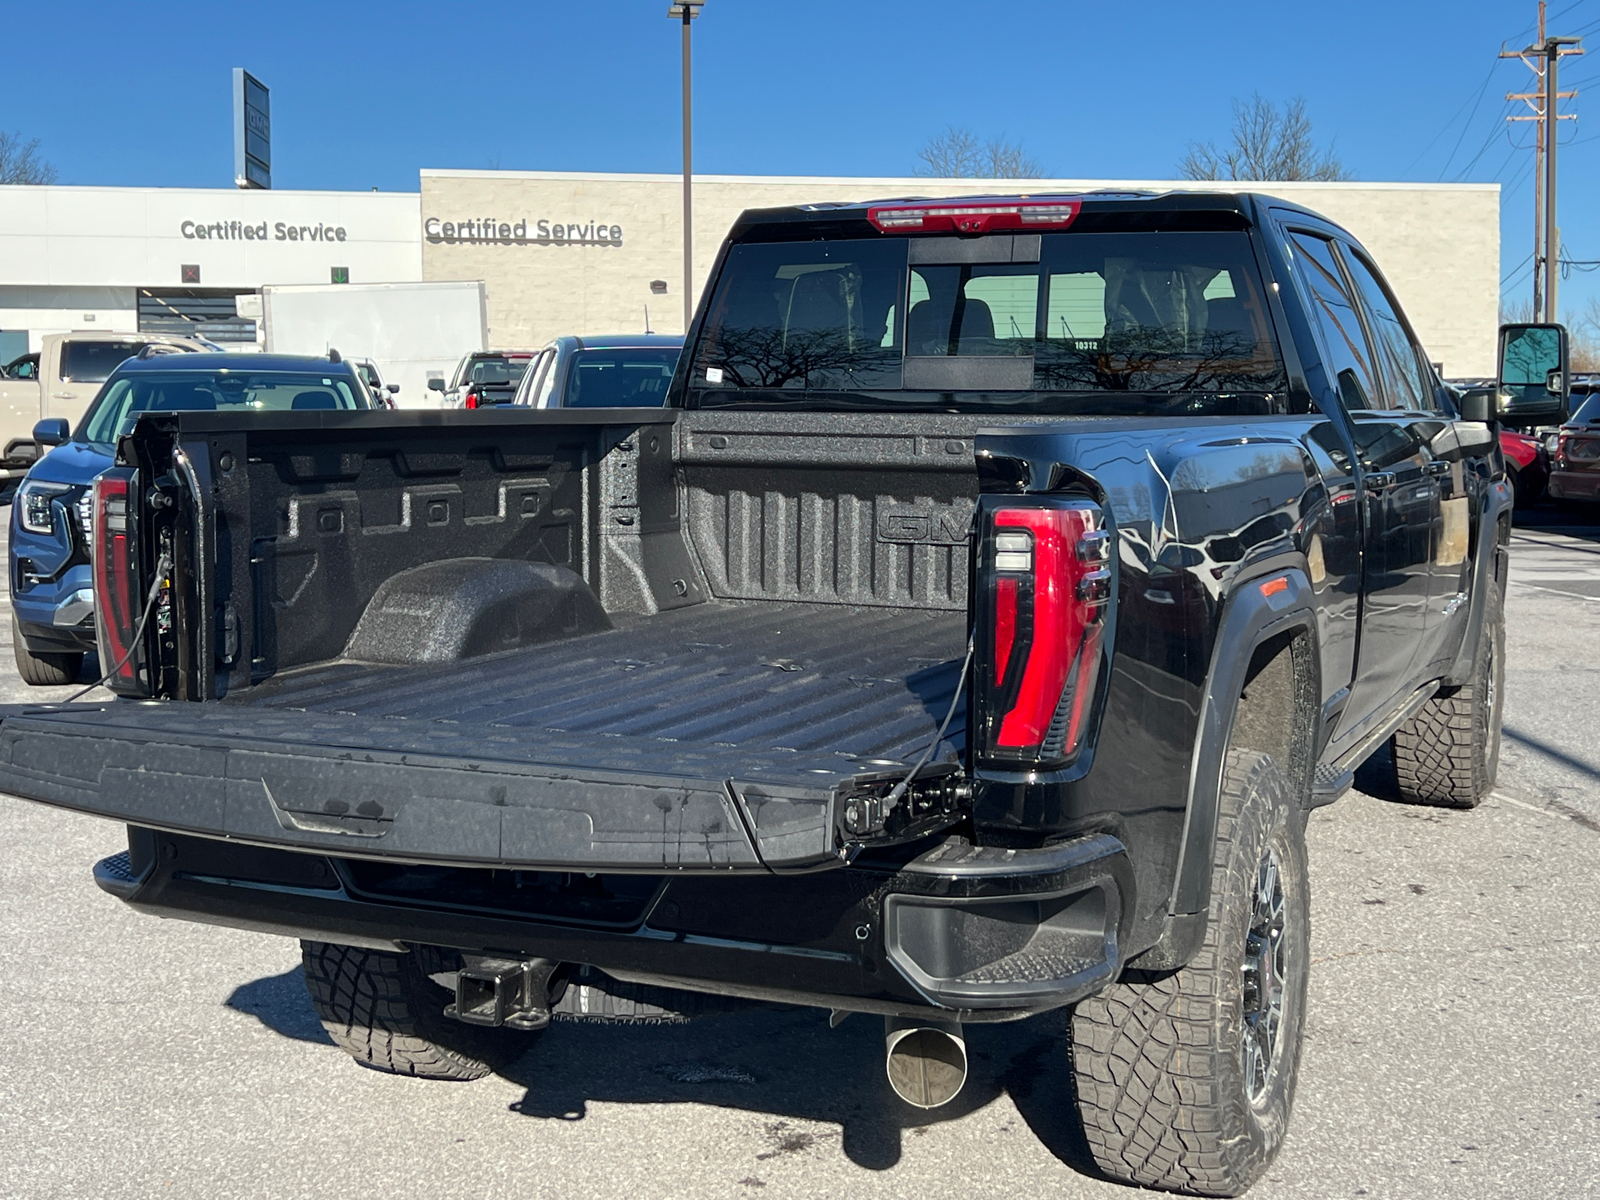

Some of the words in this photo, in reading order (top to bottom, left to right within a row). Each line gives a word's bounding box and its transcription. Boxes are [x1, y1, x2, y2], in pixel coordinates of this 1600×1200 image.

[180, 220, 268, 240] Certified
[274, 222, 347, 242] Service
[424, 217, 527, 239] Certified
[536, 219, 623, 243] Service
[1074, 341, 1098, 350] 10312
[878, 505, 975, 542] GM
